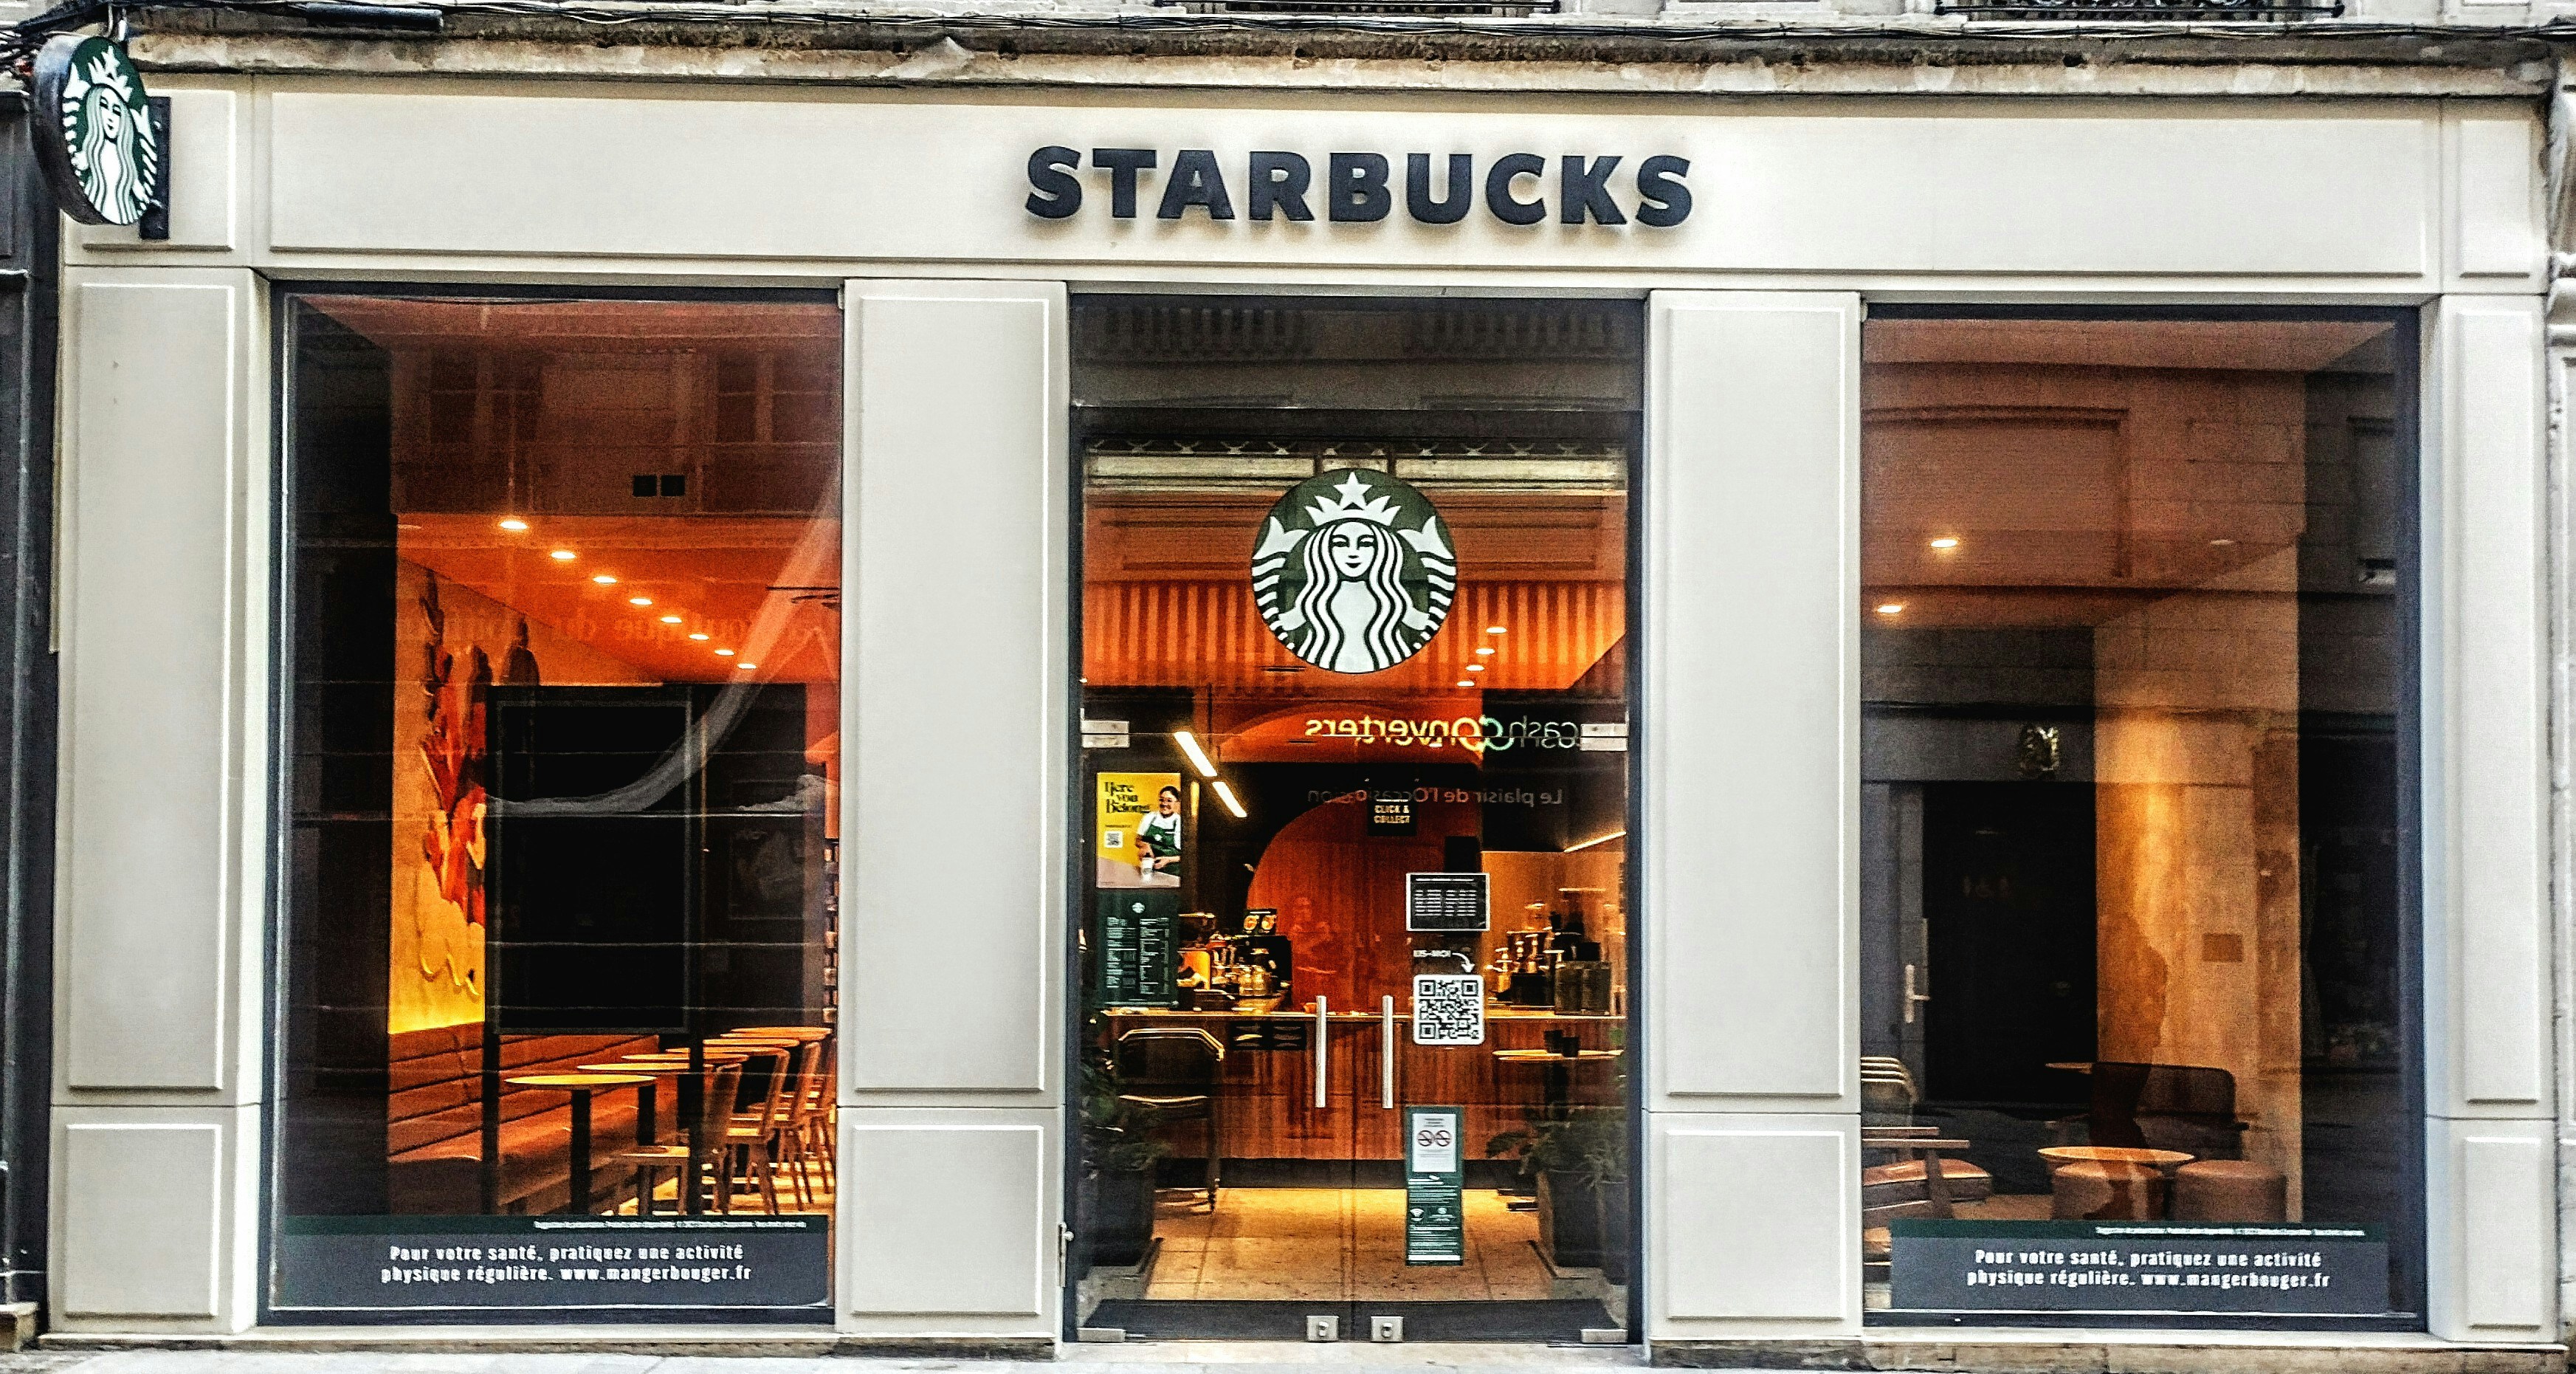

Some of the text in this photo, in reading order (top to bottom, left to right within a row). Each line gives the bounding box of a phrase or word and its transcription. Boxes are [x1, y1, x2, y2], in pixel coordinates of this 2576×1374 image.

[1025, 146, 1691, 227] STARBUCKS
[390, 1246, 429, 1260] Pour
[435, 1247, 481, 1260] votre
[549, 1246, 632, 1262] pratiquez
[638, 1248, 669, 1259] une
[675, 1245, 743, 1259] activité
[1975, 1250, 2013, 1263] Pour
[2019, 1251, 2064, 1264] votre
[2130, 1251, 2211, 1268] pratiquez
[2217, 1254, 2248, 1266] une
[2254, 1252, 2321, 1267] activité
[382, 1266, 461, 1284] physique
[559, 1265, 751, 1282] www.mangerbouger.fr
[1967, 1269, 2044, 1286] physique
[2141, 1273, 2329, 1290] www.mangerbouger.fr
